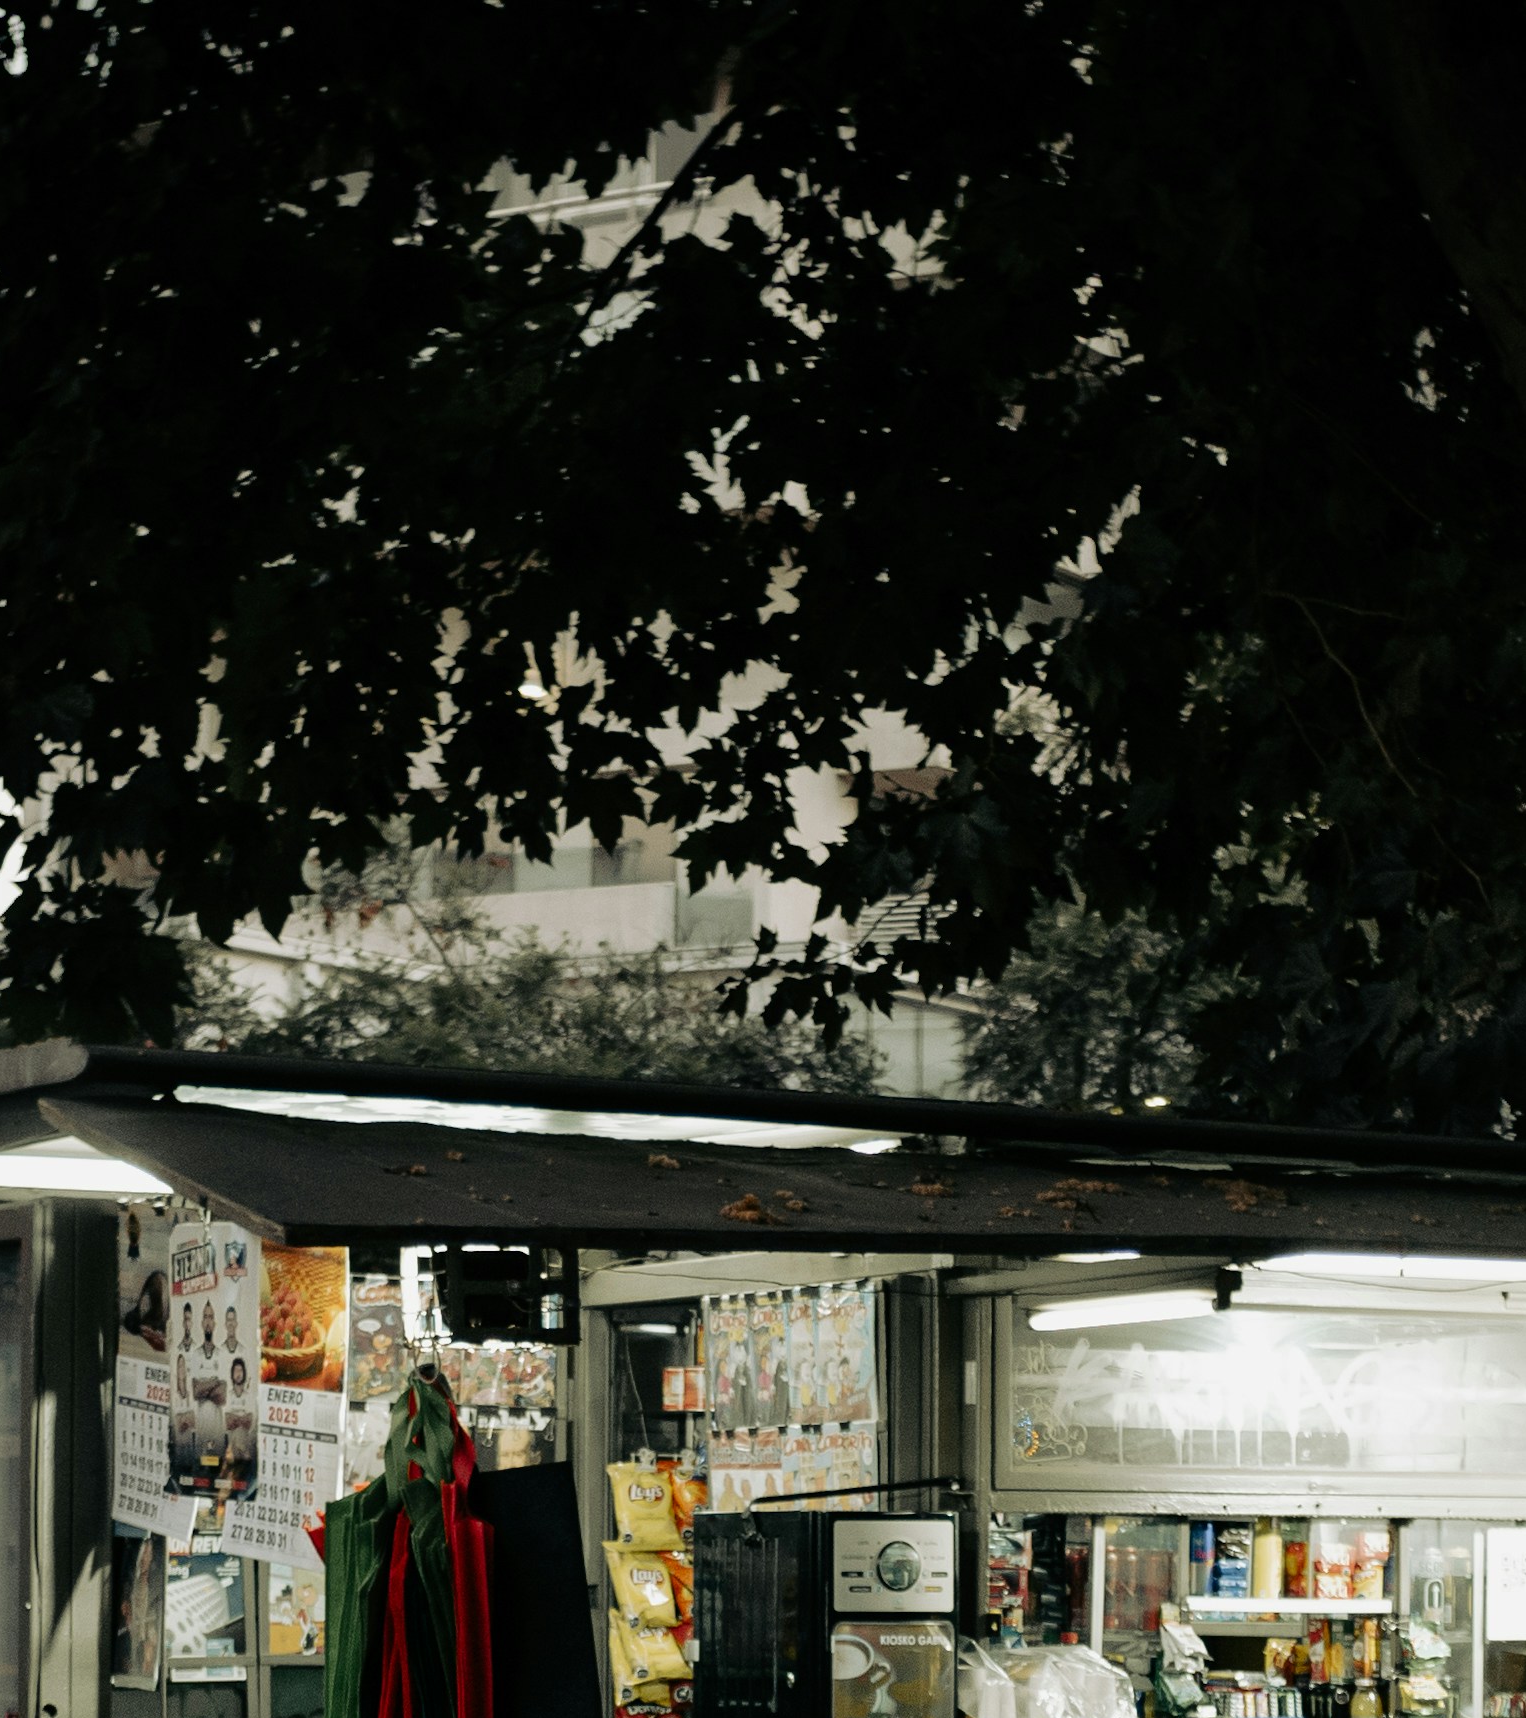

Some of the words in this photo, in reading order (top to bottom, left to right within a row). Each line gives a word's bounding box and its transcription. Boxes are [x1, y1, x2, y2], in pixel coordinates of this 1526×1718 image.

[267, 1387, 304, 1406] ENERO
[268, 1405, 299, 1426] 2025
[880, 1635, 916, 1646] KIOSKO
